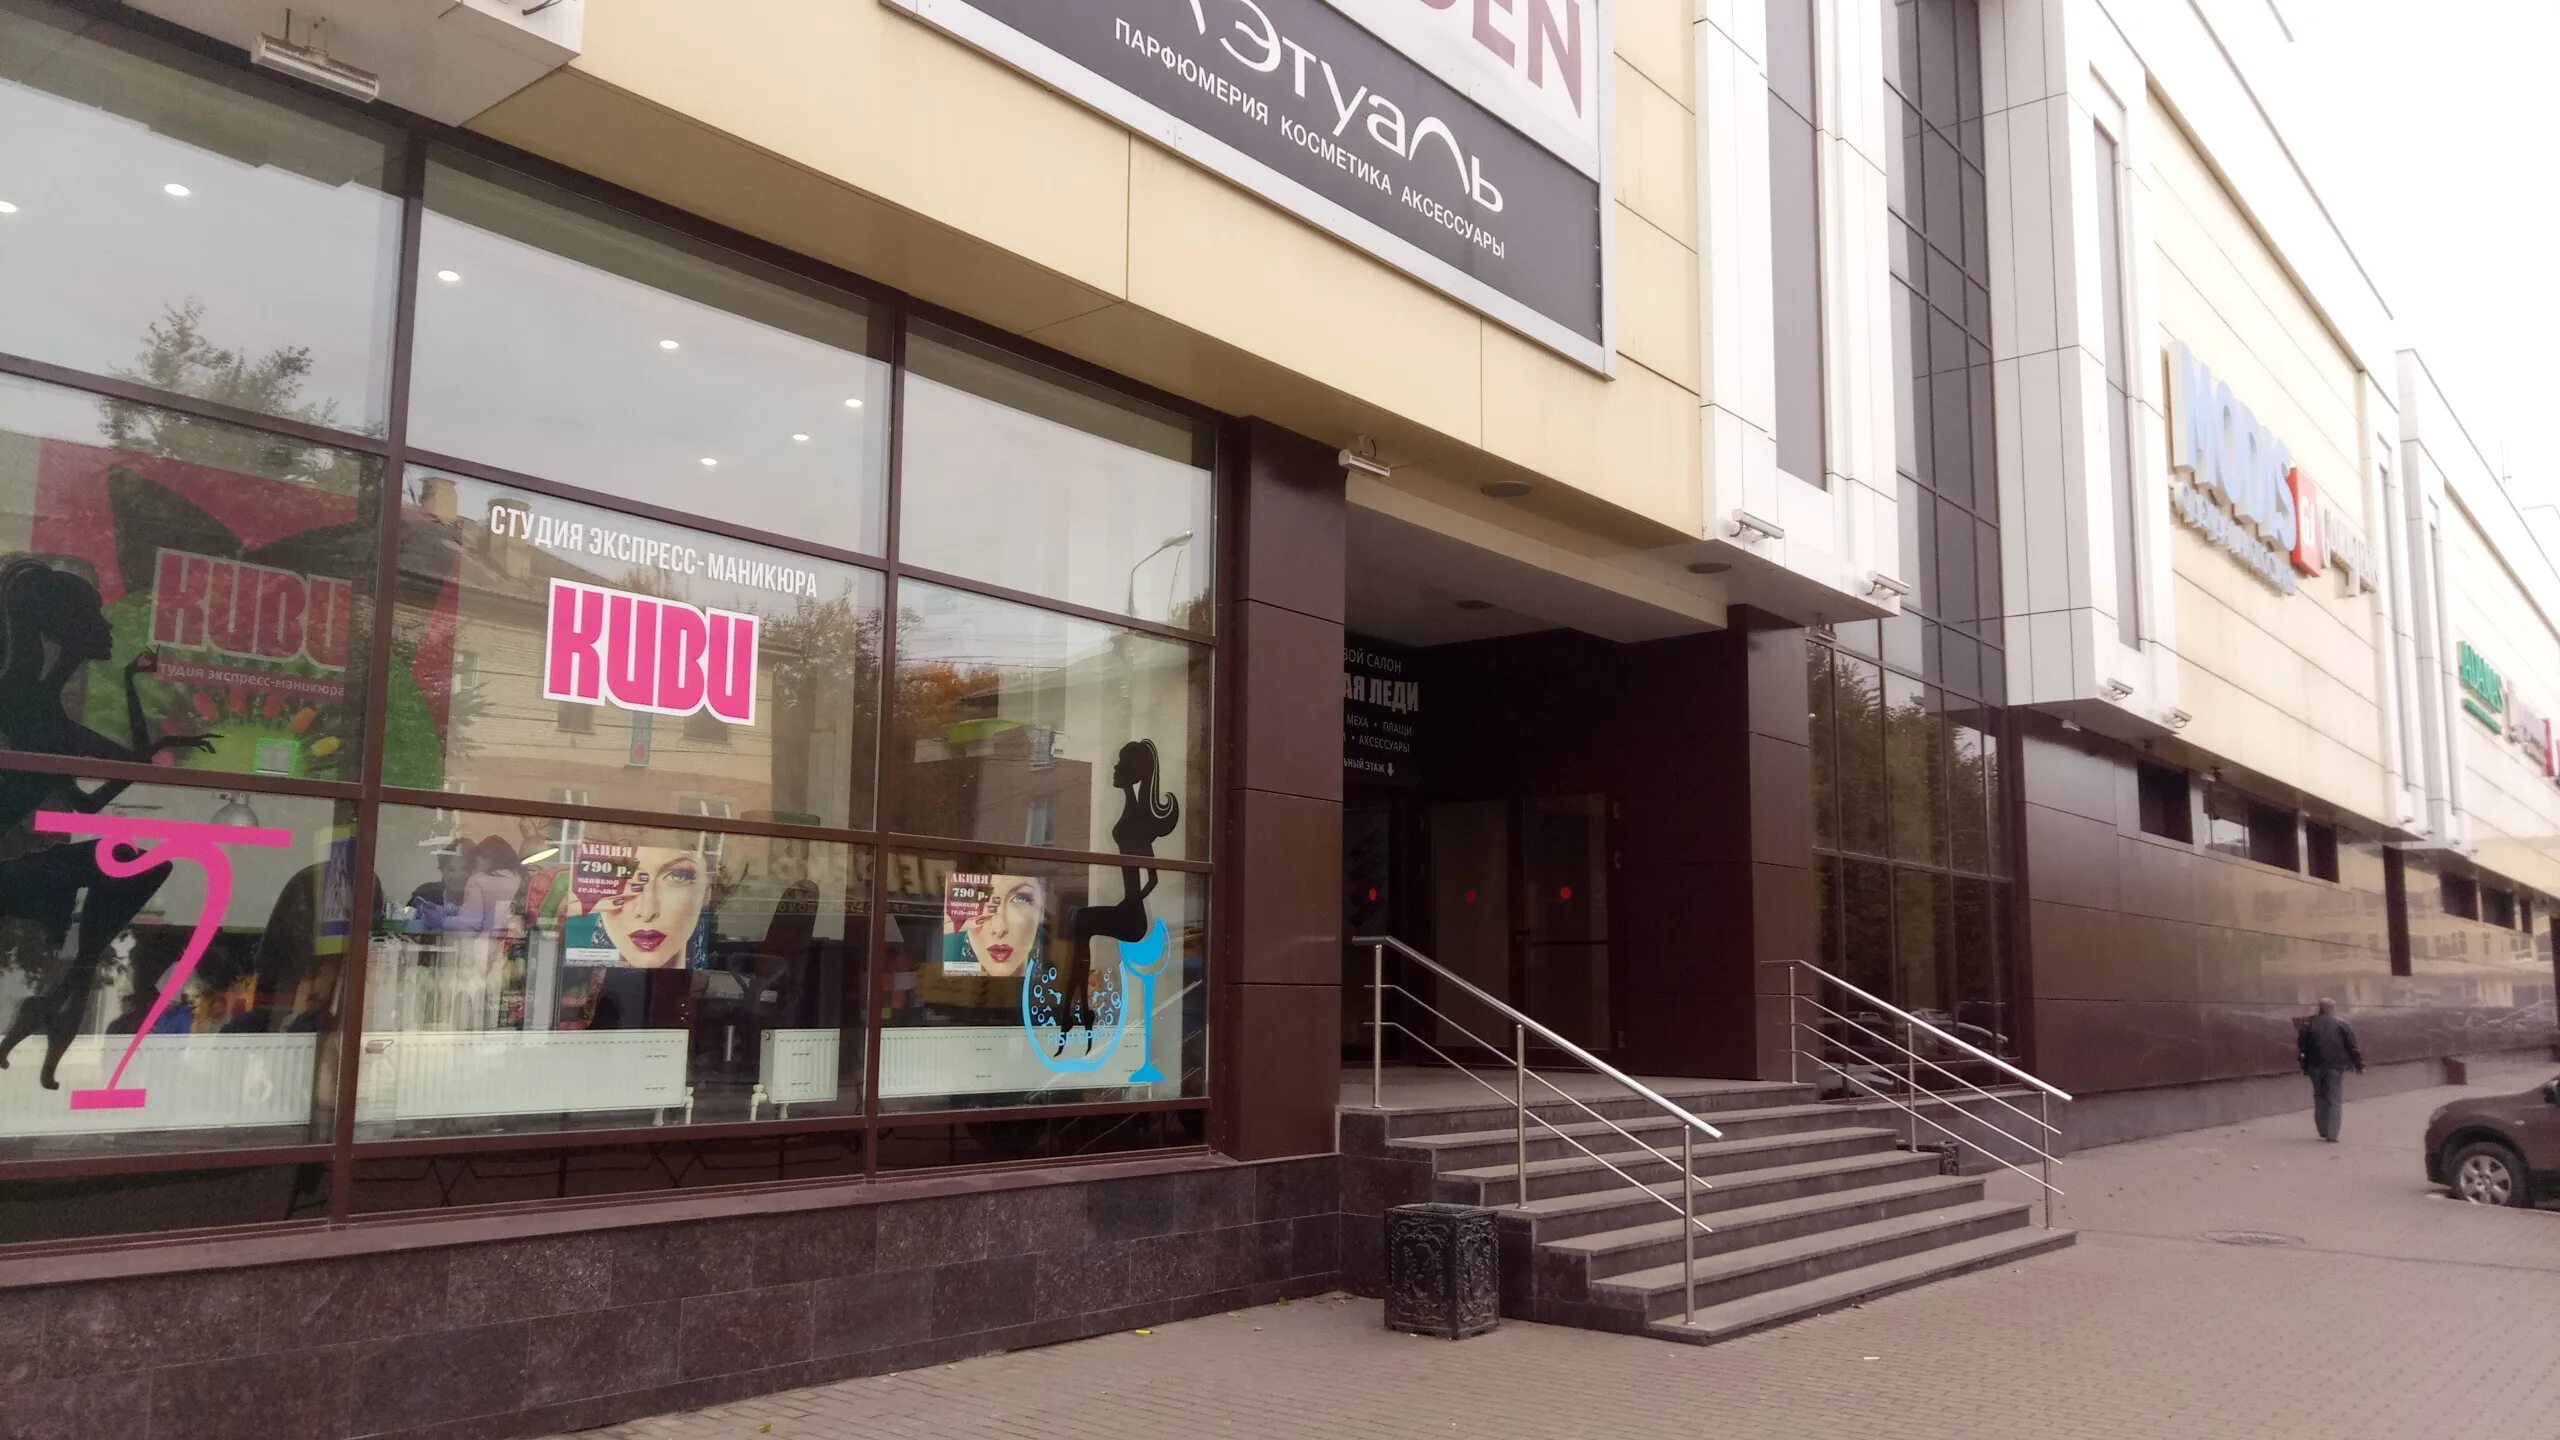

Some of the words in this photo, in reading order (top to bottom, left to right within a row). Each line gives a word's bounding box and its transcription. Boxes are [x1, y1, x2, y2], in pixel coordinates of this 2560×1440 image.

[1116, 17, 1268, 125] ПАРФЮМЕРИЯ
[1281, 115, 1392, 195] КОСМЕТИКА
[1401, 186, 1505, 259] АКСЕССУАРЫ
[490, 504, 583, 551] СТУДИЯ
[1367, 653, 1402, 673] САЛОН
[1369, 678, 1419, 714] ЛЕДИ
[1346, 714, 1369, 728] МЕХА
[1383, 721, 1412, 736] ПЛАЩИ
[1359, 735, 1410, 753] АКСЕССУАРЫ
[1365, 761, 1386, 773] ЭТАЖ
[580, 843, 632, 858] АКЦИЯ
[580, 860, 612, 873] 790
[950, 872, 988, 884] АКЦИЯ
[952, 886, 974, 898] 790
